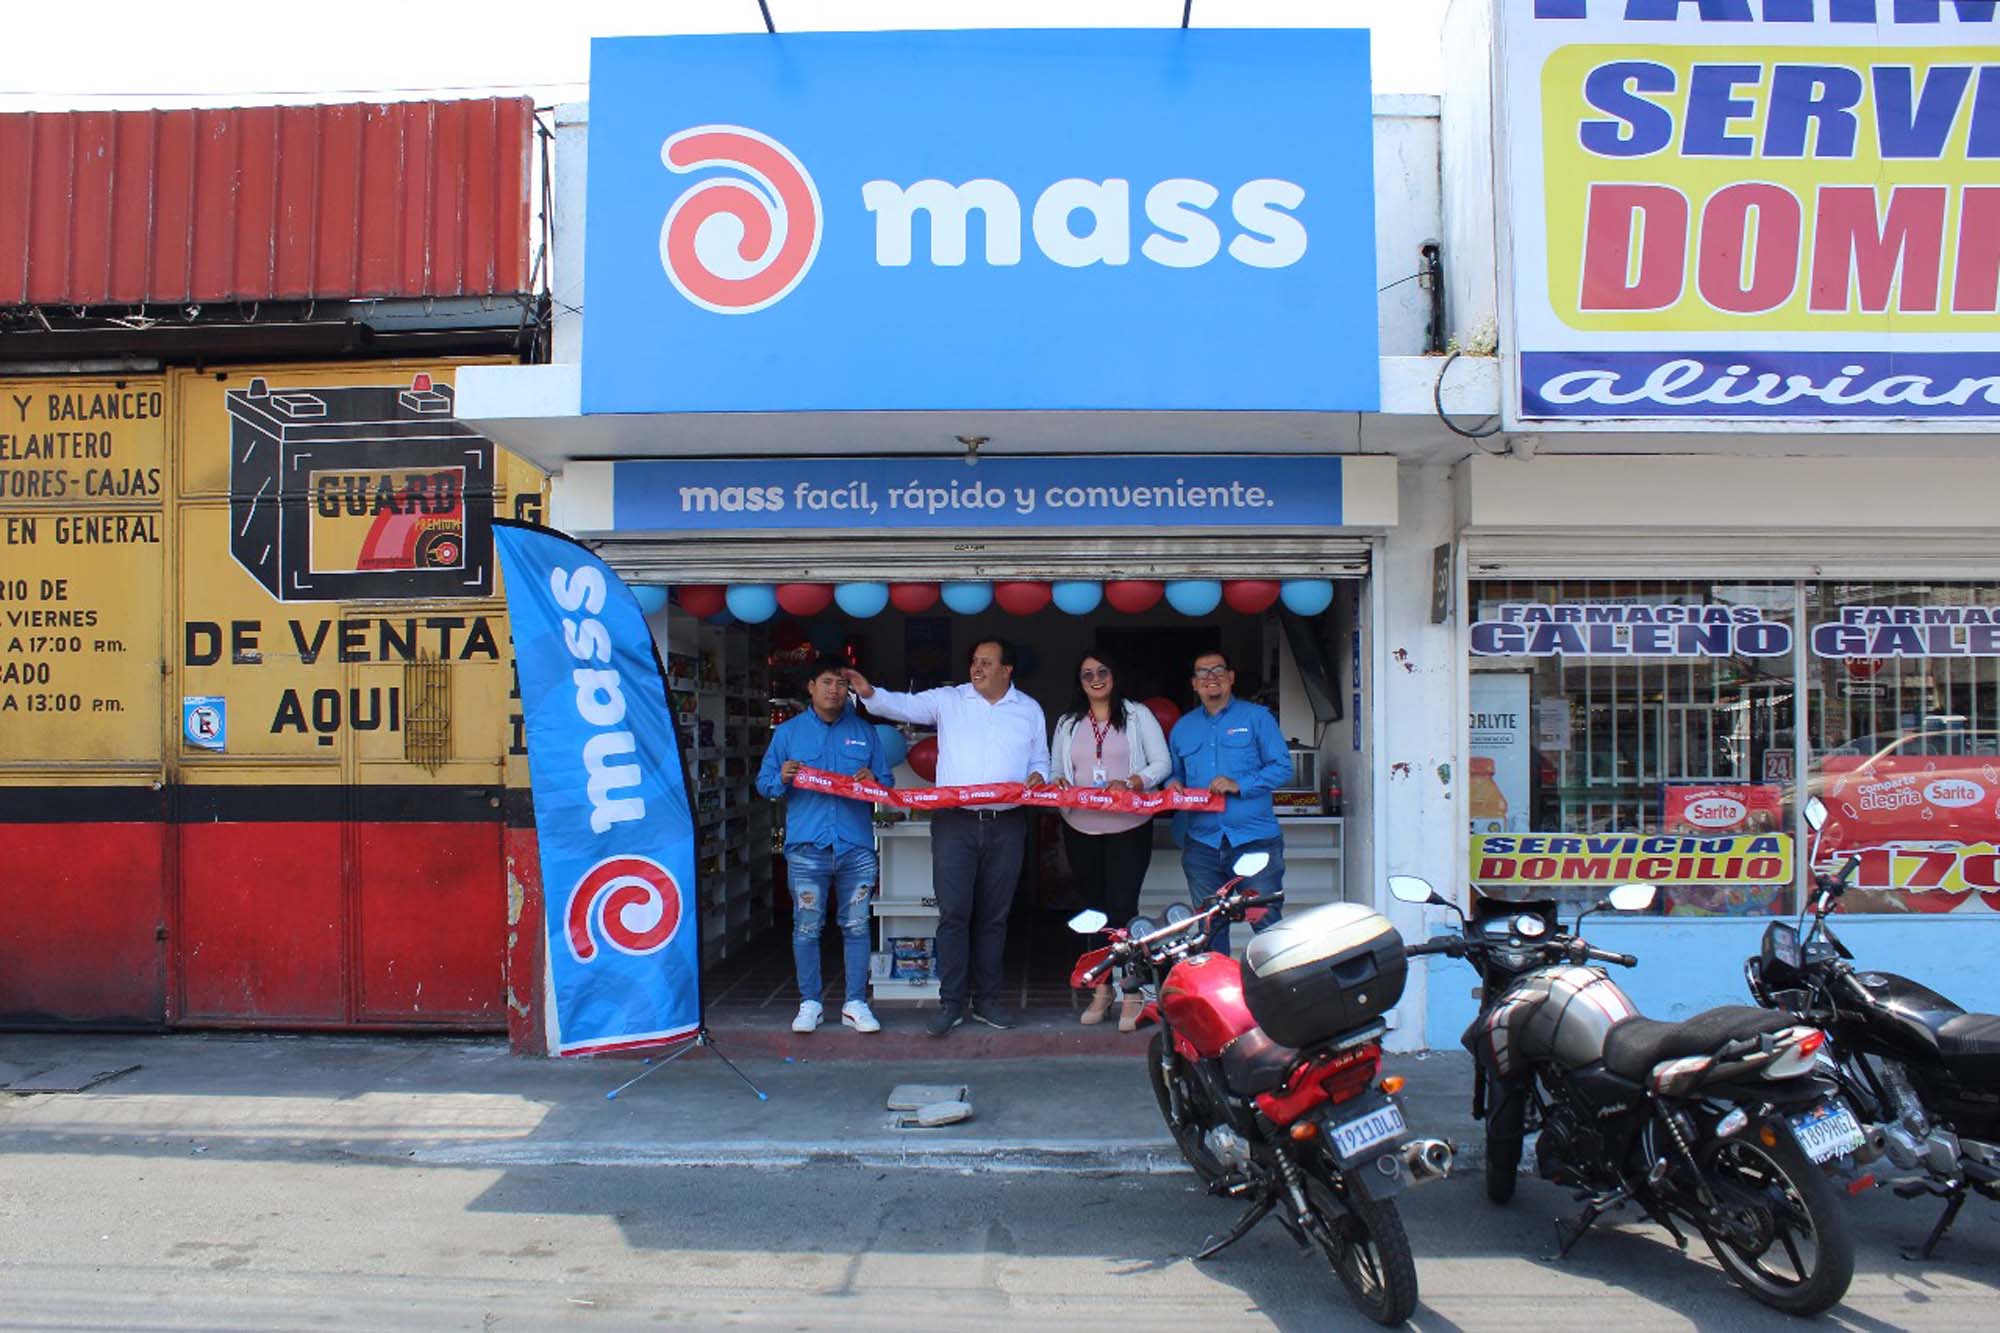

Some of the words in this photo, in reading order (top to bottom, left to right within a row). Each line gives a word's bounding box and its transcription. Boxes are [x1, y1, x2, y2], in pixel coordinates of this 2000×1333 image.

[862, 178, 1308, 268] mass
[13, 395, 32, 422] Y
[48, 392, 162, 421] BALANCEO
[0, 431, 112, 460] ELANTERO
[317, 473, 462, 518] GUARD
[679, 485, 785, 512] mass
[888, 480, 1006, 515] rápido
[1014, 488, 1036, 514] y
[1044, 478, 1275, 508] conveniente.
[7, 517, 37, 545] EN
[55, 516, 160, 544] GENERAL
[416, 517, 462, 534] PREMIUM
[40, 580, 68, 600] DE
[7, 611, 97, 627] VIERNES
[1499, 604, 1762, 624] FARMACIAS
[8, 637, 23, 652] A
[30, 636, 82, 652] 17:00
[185, 620, 262, 666] DE
[288, 617, 500, 664] VENTA
[1470, 622, 1792, 657] GALENO
[0, 662, 50, 685] ADO
[3, 694, 18, 711] A
[27, 694, 81, 712] 13:00
[551, 565, 646, 834] mass
[1858, 776, 1916, 795] Comparte
[1931, 784, 1976, 800] Sarita
[1860, 791, 1923, 811] alegría
[1694, 804, 1737, 820] Sarita
[1745, 837, 1780, 853] A
[1478, 857, 1782, 880] DOMICILIO
